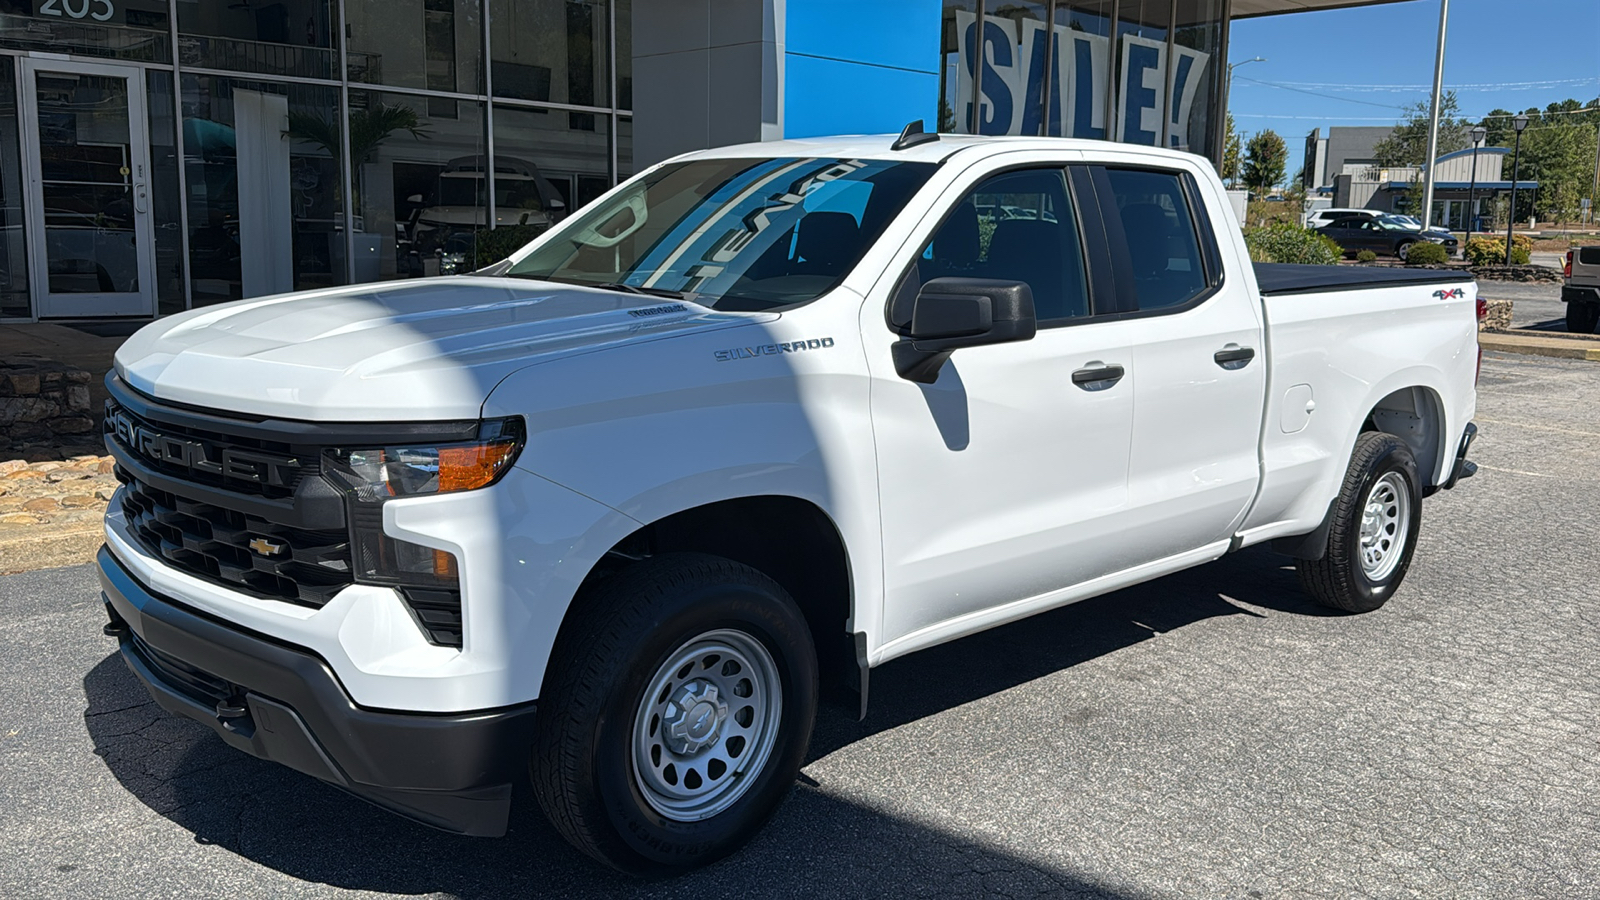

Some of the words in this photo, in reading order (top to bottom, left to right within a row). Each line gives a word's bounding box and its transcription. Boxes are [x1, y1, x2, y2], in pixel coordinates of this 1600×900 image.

[965, 20, 1195, 147] SALE!
[714, 337, 834, 361] SILVERADO
[104, 398, 302, 486] CHEVROLET
